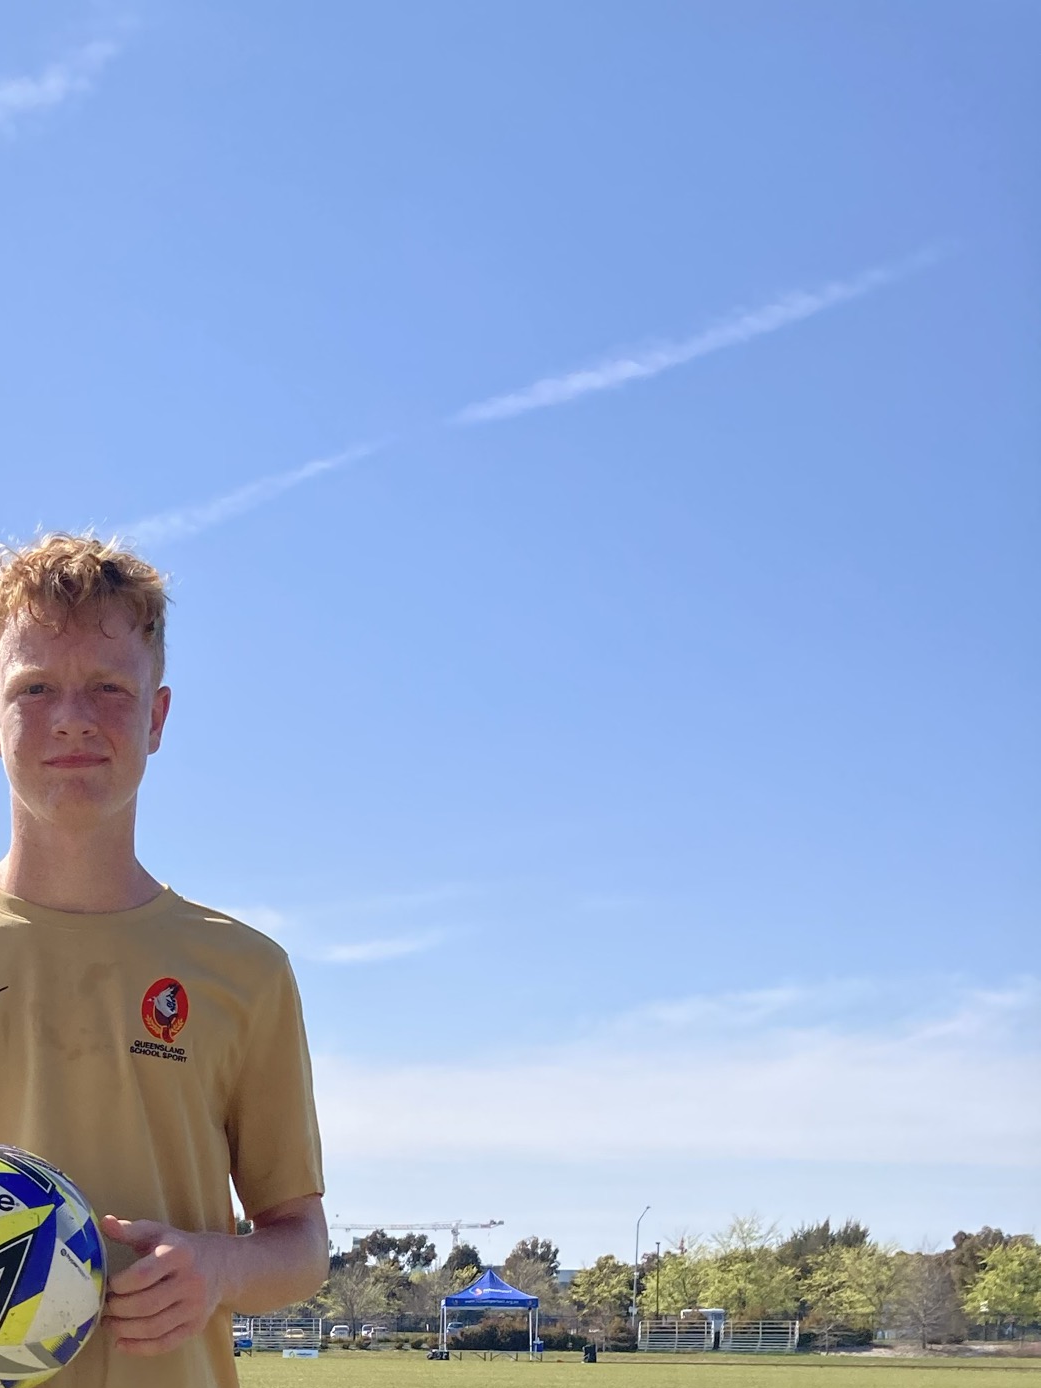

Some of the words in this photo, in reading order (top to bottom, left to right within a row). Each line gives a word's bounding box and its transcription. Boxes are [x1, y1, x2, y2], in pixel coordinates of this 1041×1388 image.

[130, 1046, 161, 1058] SCHOOL
[162, 1052, 188, 1063] SPORT
[134, 1040, 185, 1055] QUEENSLAND
